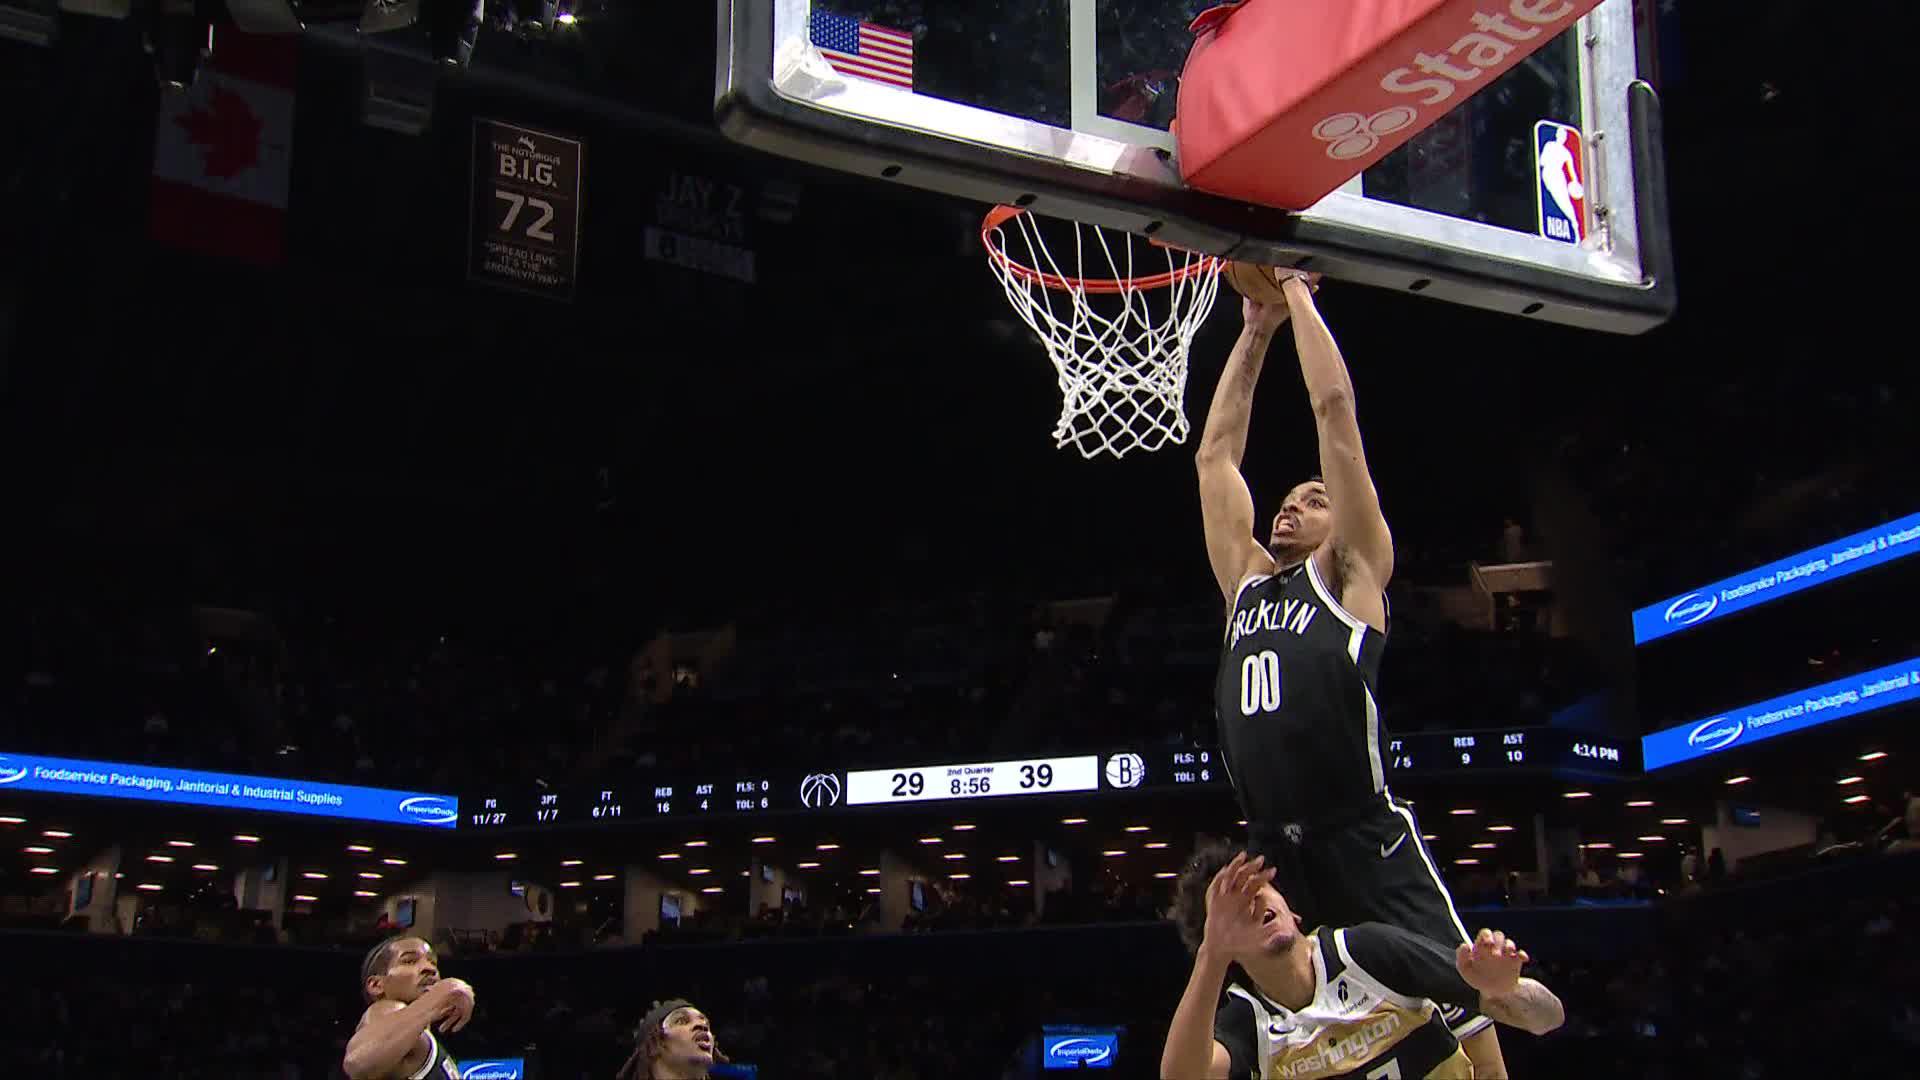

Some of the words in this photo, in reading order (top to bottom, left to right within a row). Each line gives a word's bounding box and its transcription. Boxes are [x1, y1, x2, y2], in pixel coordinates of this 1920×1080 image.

[1381, 0, 1574, 104] State
[499, 153, 558, 188] B.I.G.
[495, 188, 555, 242] 72
[1546, 215, 1572, 240] NBA
[1877, 536, 1888, 550] &
[1241, 649, 1280, 717] 00
[1453, 736, 1475, 748] REB
[1503, 733, 1524, 745] AST
[1200, 751, 1209, 763] 0
[1461, 752, 1471, 765] 9
[1506, 750, 1522, 763] 10
[1572, 743, 1598, 759] 4:14
[1599, 746, 1619, 761] PM
[947, 767, 962, 777] 2nd
[963, 765, 995, 776] Quarter
[1019, 763, 1053, 788] 39
[1174, 771, 1196, 783] TOL:
[1200, 769, 1210, 781] 6
[34, 766, 107, 784] Foodservice
[110, 773, 173, 792] Packaging,
[176, 779, 229, 795] Janitorial
[231, 784, 240, 796] &
[243, 785, 294, 801] Industrial
[297, 790, 342, 806] Supplies
[696, 784, 713, 794] AST
[761, 781, 769, 791] 0
[891, 772, 924, 797] 29
[950, 777, 991, 795] 8:56
[601, 791, 612, 801] FT
[655, 787, 673, 798] REB
[656, 803, 670, 813] 16
[701, 800, 708, 810] 4
[736, 799, 754, 810] TOL:
[761, 798, 768, 808] 6
[1275, 1012, 1401, 1080] washington
